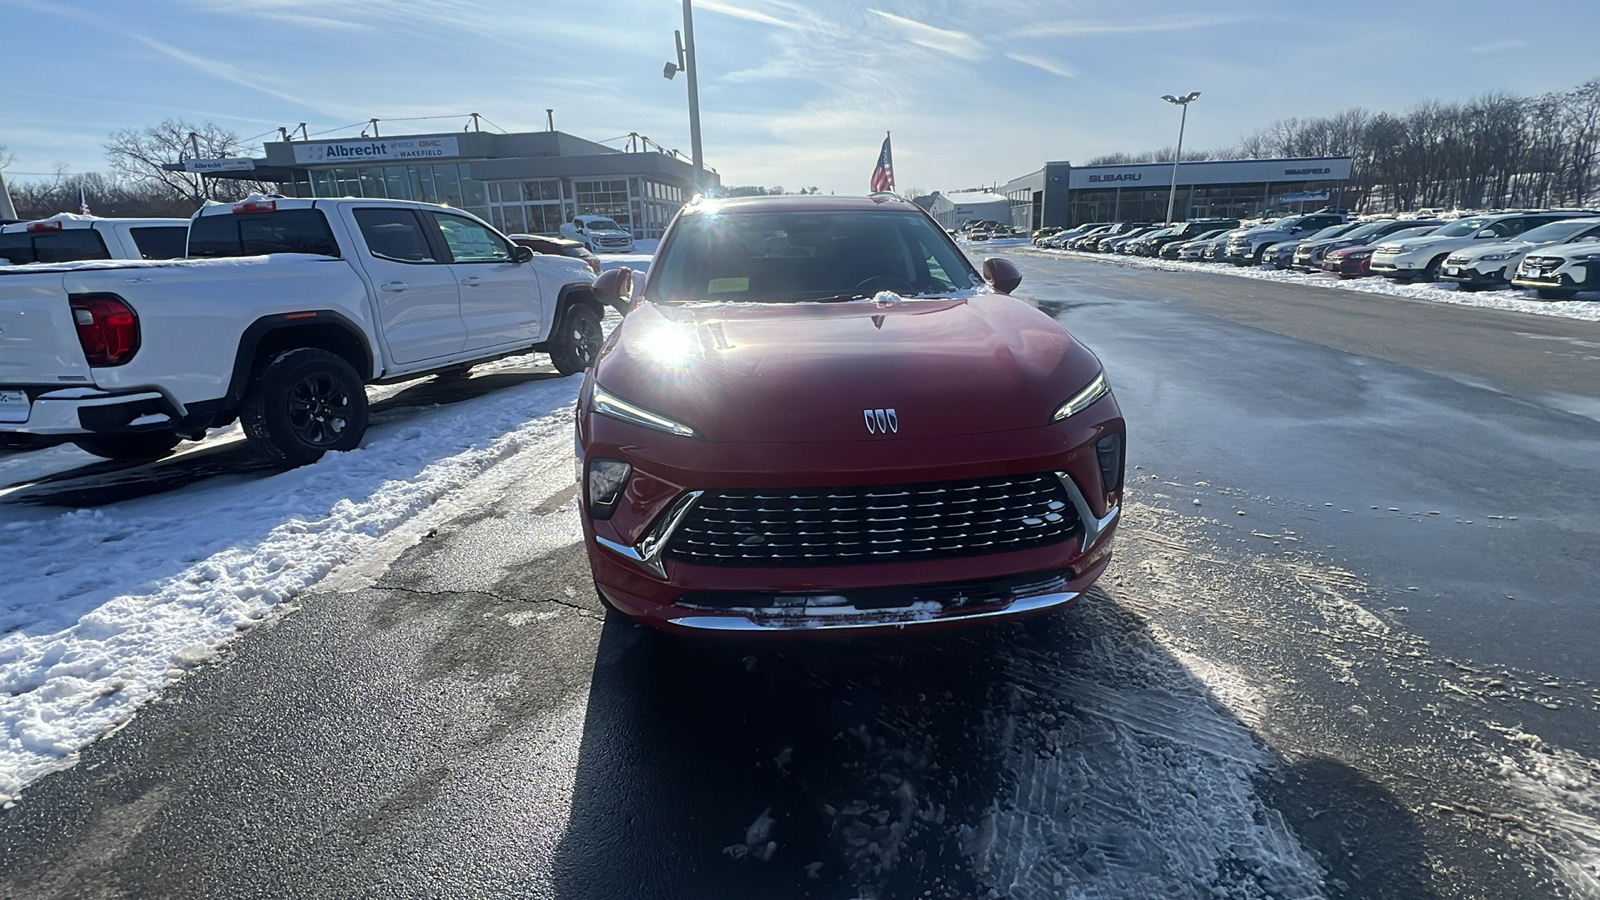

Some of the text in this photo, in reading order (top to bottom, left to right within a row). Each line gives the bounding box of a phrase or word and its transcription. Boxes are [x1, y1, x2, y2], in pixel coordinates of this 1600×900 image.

[326, 143, 387, 157] Albrecht
[400, 149, 443, 158] WAKEFIELD
[1088, 173, 1142, 183] SUBARU
